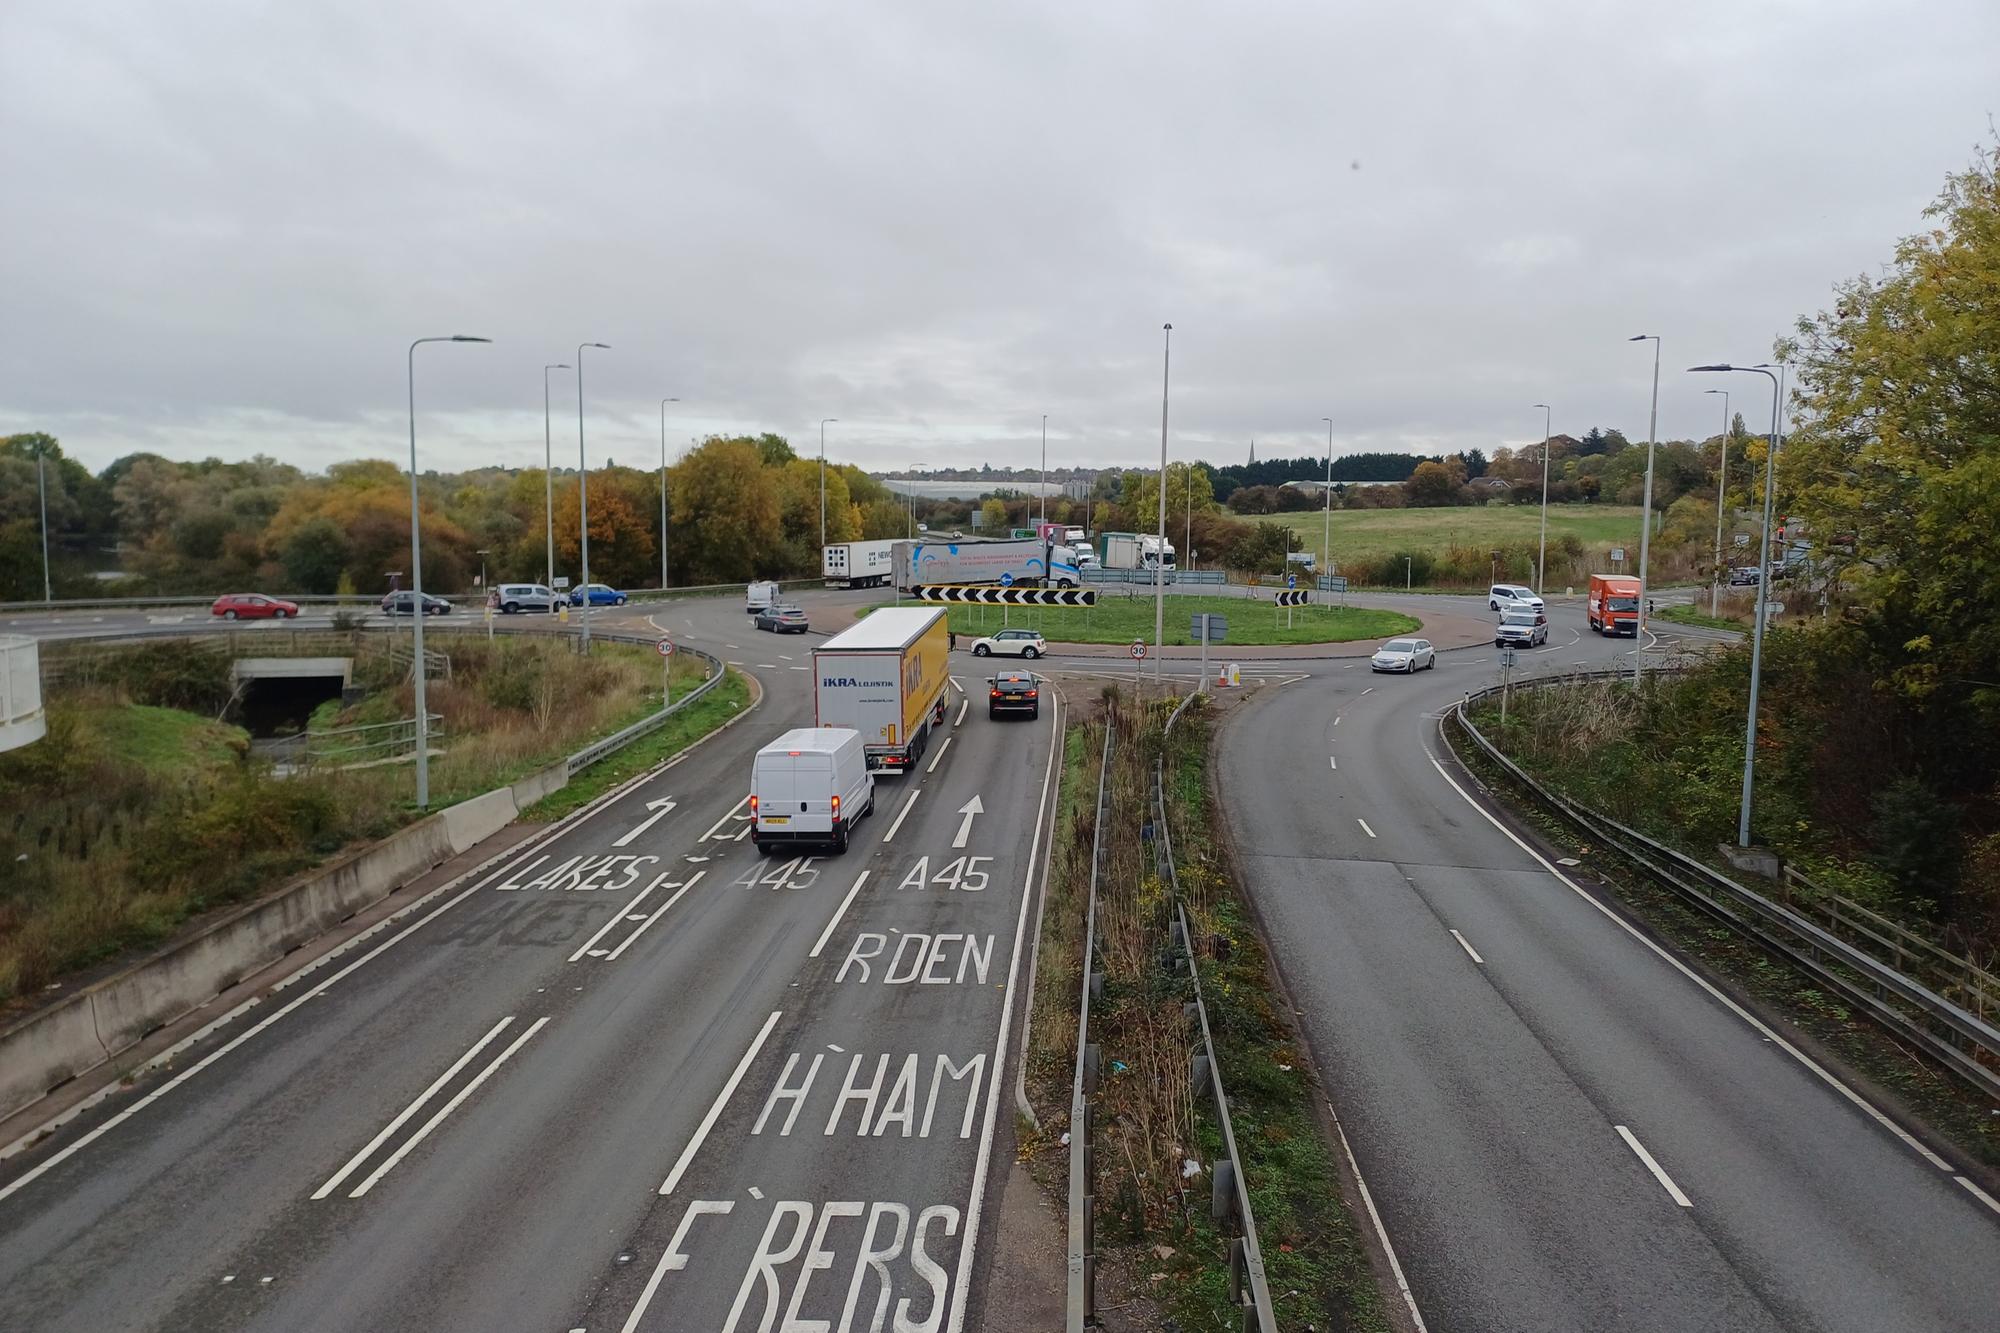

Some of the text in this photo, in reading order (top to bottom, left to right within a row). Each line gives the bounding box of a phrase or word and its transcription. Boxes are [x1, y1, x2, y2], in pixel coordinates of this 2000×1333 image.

[659, 643, 670, 651] 30
[1132, 646, 1144, 655] 30
[496, 855, 659, 890] LAKES
[730, 856, 826, 890] A45
[898, 856, 994, 891] A45
